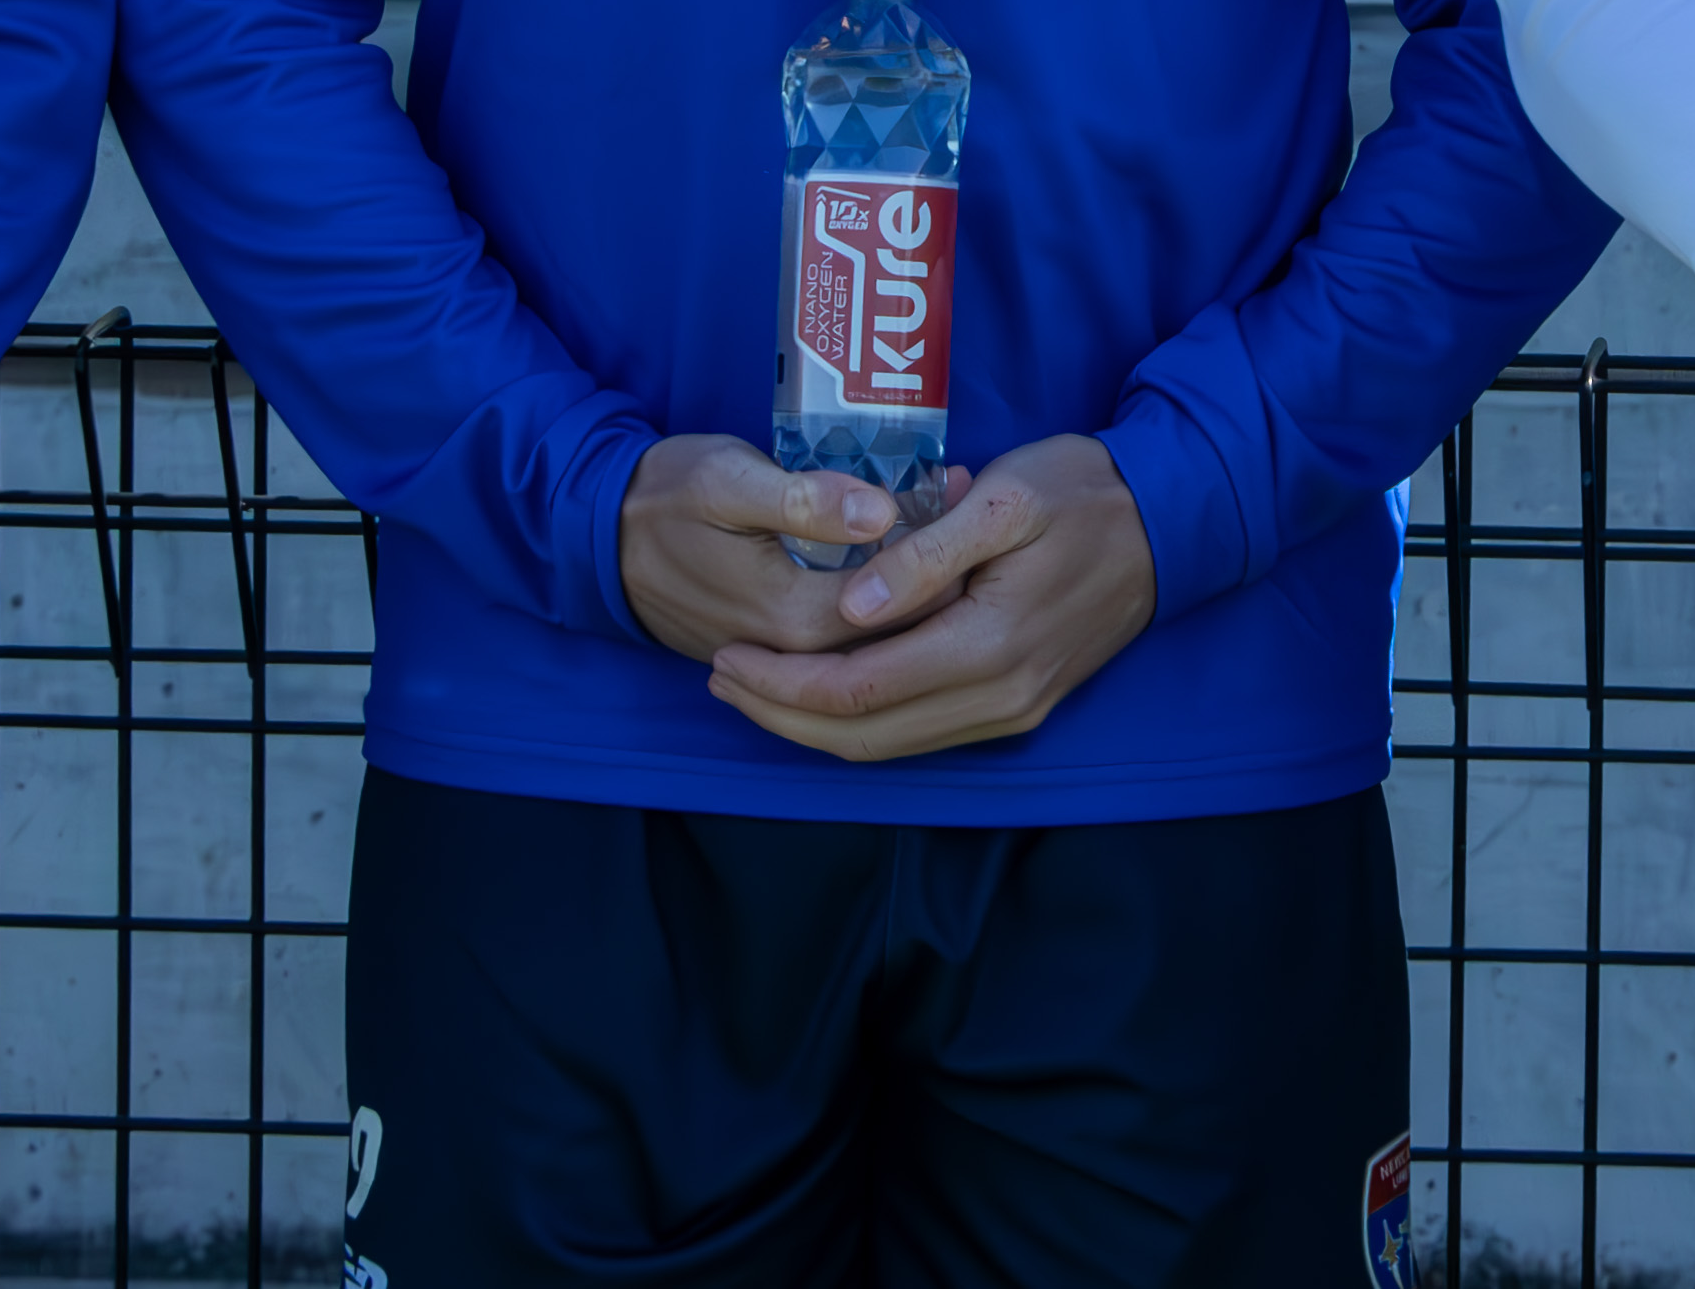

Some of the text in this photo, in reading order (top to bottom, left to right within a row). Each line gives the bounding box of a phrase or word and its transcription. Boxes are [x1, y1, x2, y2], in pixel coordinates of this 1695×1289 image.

[828, 220, 869, 231] OXYGEN
[805, 263, 819, 335] NANO
[816, 250, 834, 354] OXYGEN
[831, 274, 849, 361] WATER
